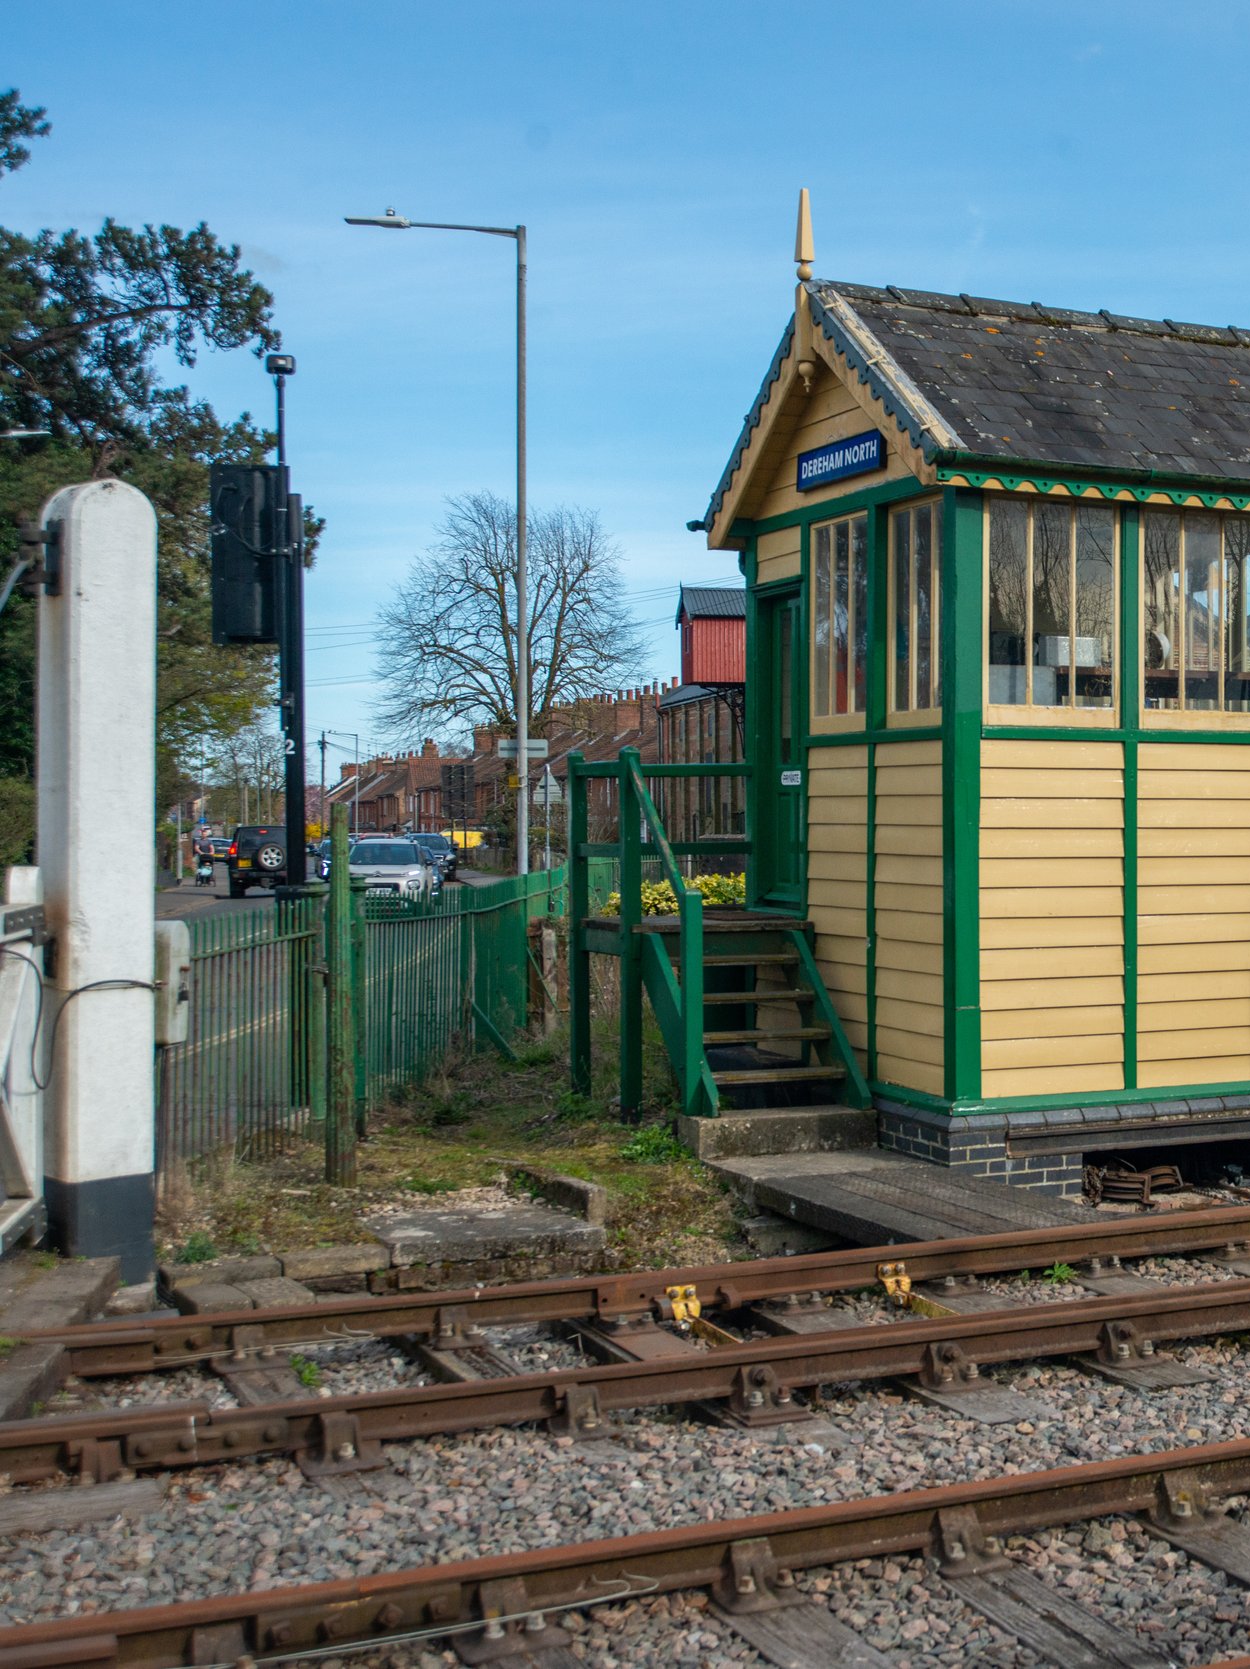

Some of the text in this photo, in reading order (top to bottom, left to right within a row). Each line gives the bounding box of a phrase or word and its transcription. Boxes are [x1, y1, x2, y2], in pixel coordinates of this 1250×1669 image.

[802, 439, 877, 479] DEREHAM NORTH
[286, 739, 295, 754] 2
